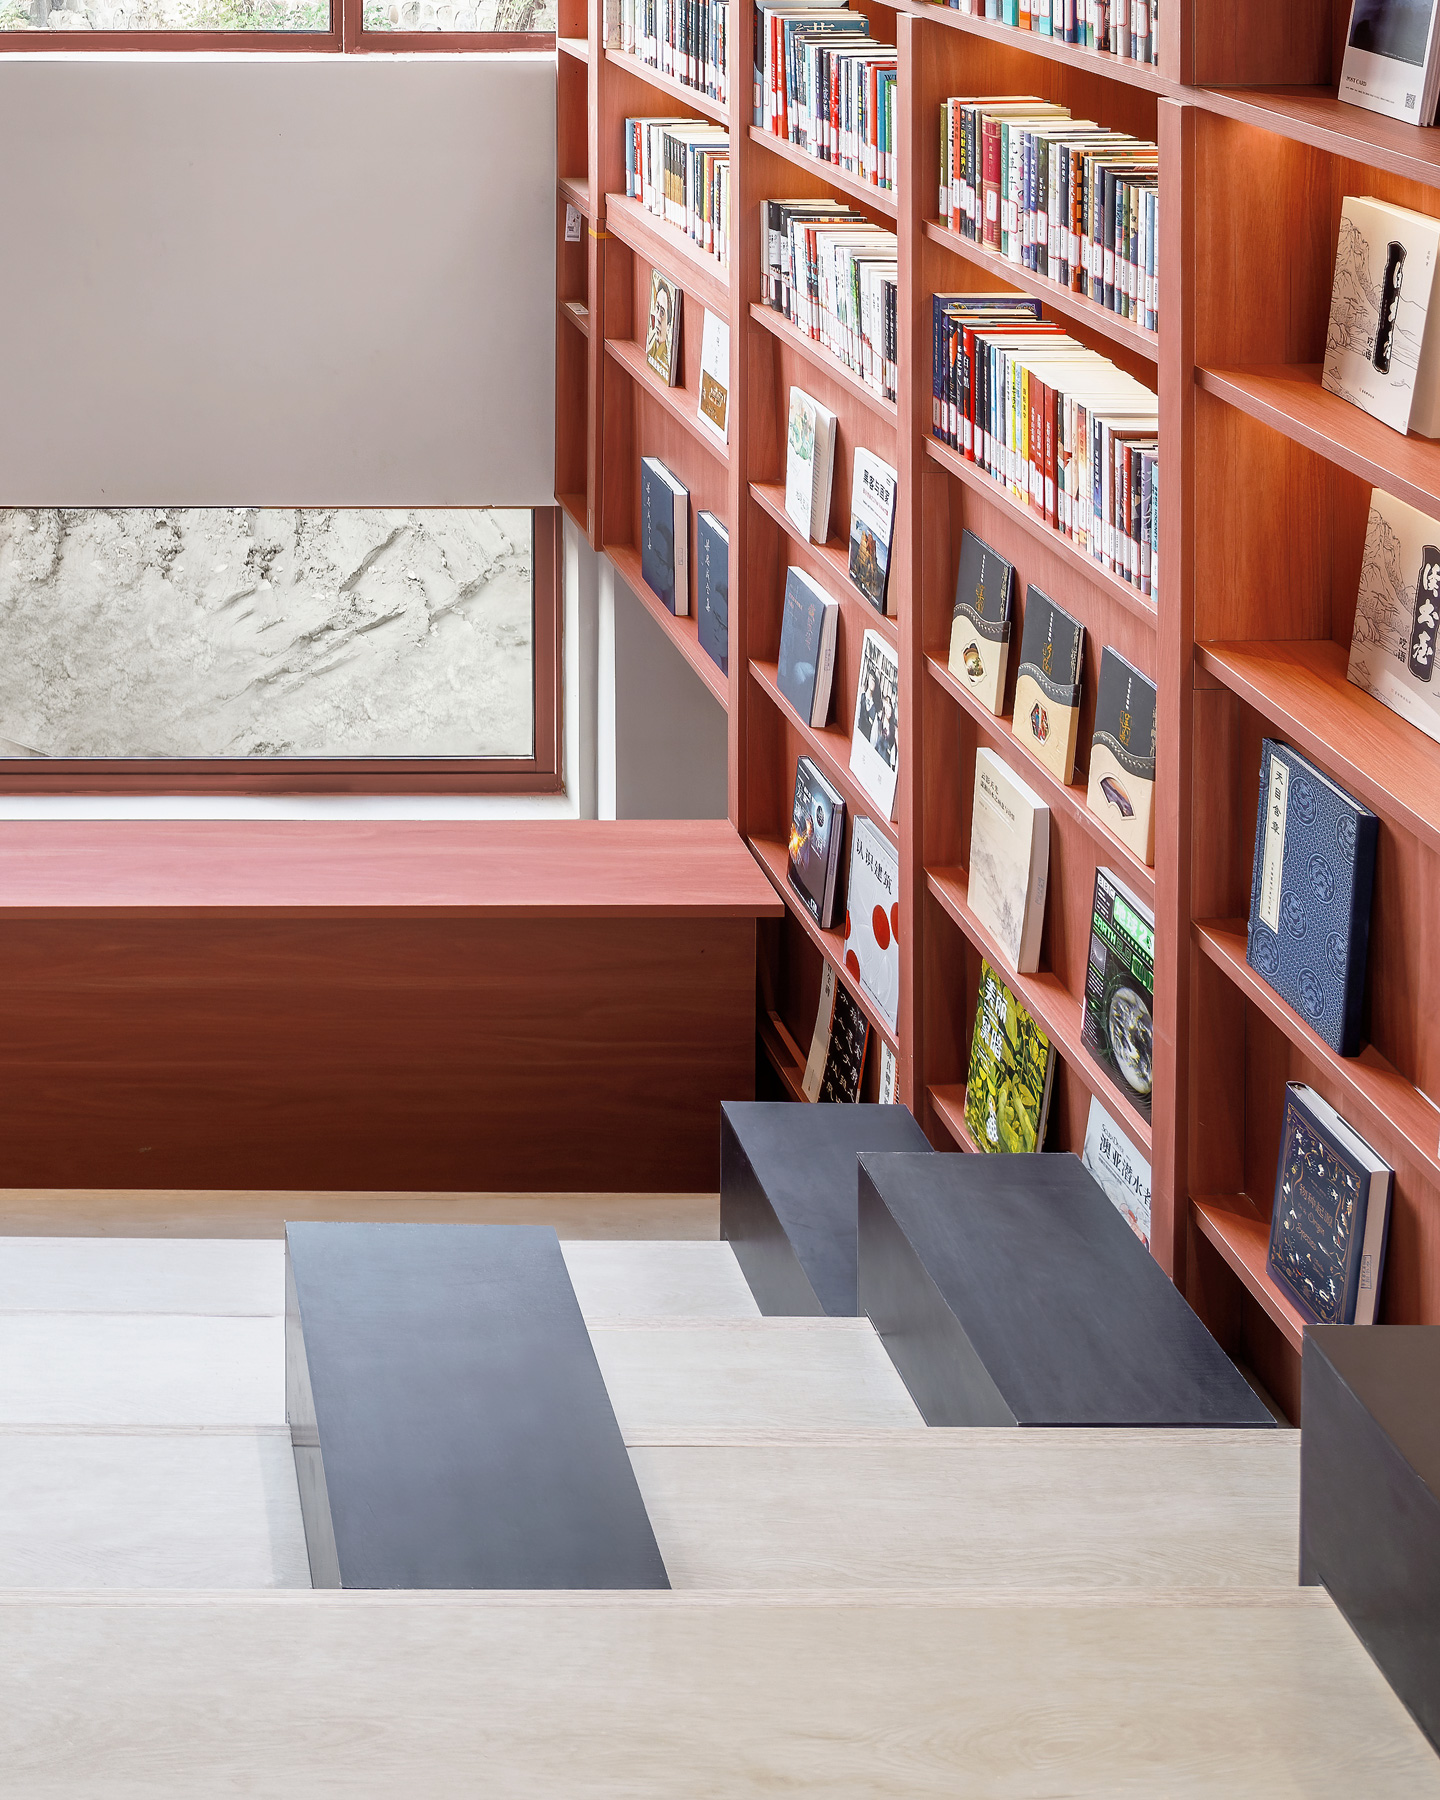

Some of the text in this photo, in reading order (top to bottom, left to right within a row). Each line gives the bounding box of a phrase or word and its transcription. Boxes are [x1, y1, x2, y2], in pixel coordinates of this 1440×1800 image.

[1346, 75, 1367, 86] POST CARD
[863, 469, 890, 507] 黑客与画家
[856, 837, 893, 896] 认识建筑
[1097, 874, 1116, 900] BBC
[986, 977, 1008, 1023] 美丽
[981, 1014, 1003, 1063] 黑暗
[1099, 1134, 1151, 1205] 澳亚潜水者
[1299, 1183, 1333, 1228] 物种起源
